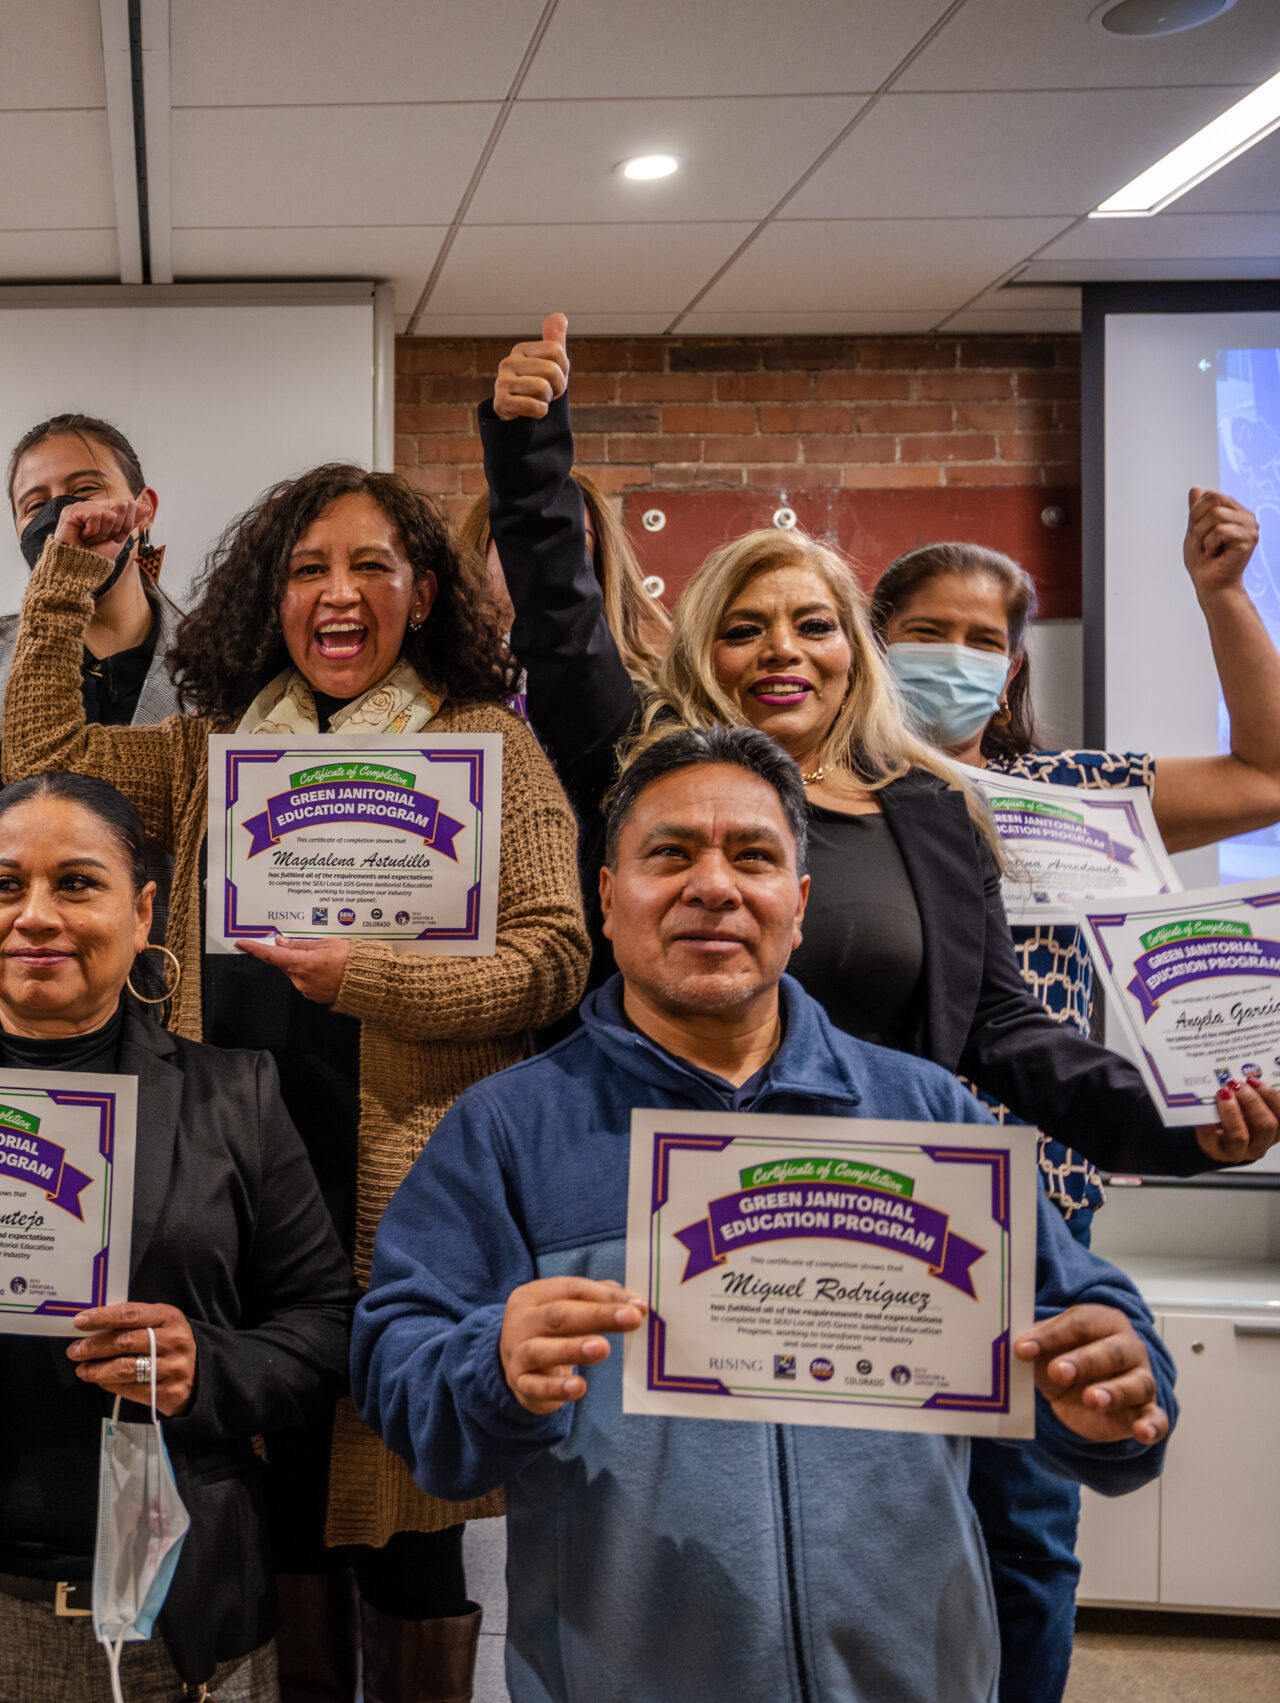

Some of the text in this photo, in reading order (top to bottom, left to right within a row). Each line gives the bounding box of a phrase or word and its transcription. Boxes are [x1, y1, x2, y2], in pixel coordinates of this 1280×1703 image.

[300, 766, 407, 785] Certificate of Completion
[290, 788, 415, 807] GREEN JANITORIAL
[992, 799, 1025, 810] Certificate
[276, 804, 429, 827] EDUCATION PROGRAM
[994, 813, 1089, 835] REEN JANITORIAL
[1043, 827, 1105, 850] PROGRAM
[272, 851, 430, 870] Magdalena Astudillo
[267, 911, 304, 920] RISING
[1184, 921, 1192, 937] of
[1194, 920, 1243, 936] Completion
[1148, 941, 1263, 970] GREEN JANITORIAL
[1145, 959, 1208, 990] EDUCATION
[1176, 1008, 1224, 1031] Angela
[753, 1161, 902, 1192] Certificate of Completion
[739, 1192, 914, 1223] GREEN JANITORIAL
[8, 1232, 55, 1242] expectations
[720, 1212, 935, 1251] EDUCATION PROGRAM
[3, 1250, 30, 1260] industry
[20, 1242, 54, 1250] Education
[722, 1272, 930, 1312] Miguel Rodríguez
[709, 1356, 762, 1372] RISING
[844, 1376, 884, 1386] COLORADO
